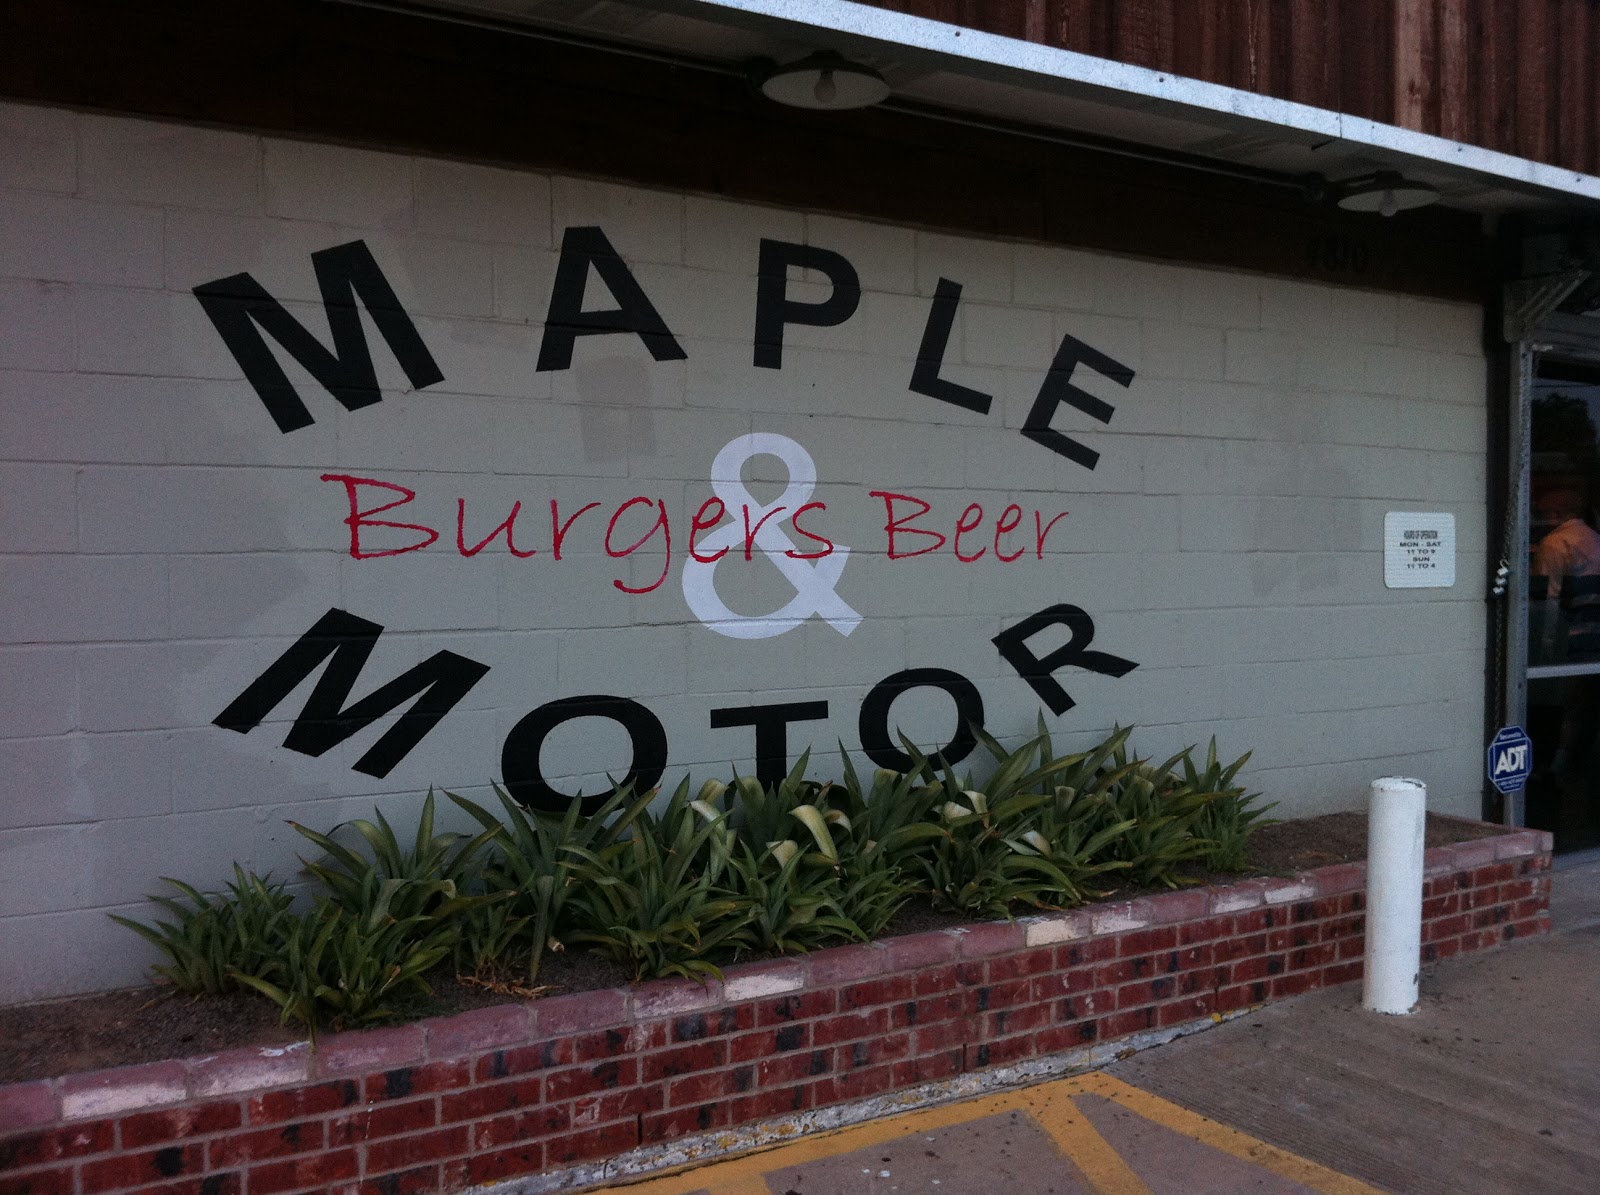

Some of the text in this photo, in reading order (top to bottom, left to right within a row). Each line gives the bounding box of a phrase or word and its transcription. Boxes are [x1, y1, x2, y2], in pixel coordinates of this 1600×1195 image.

[191, 225, 1135, 471] MAPLE
[320, 473, 1068, 594] Burgers Beer
[682, 432, 864, 639] &
[213, 602, 1140, 814] MOTOR
[1494, 744, 1528, 775] ADT
